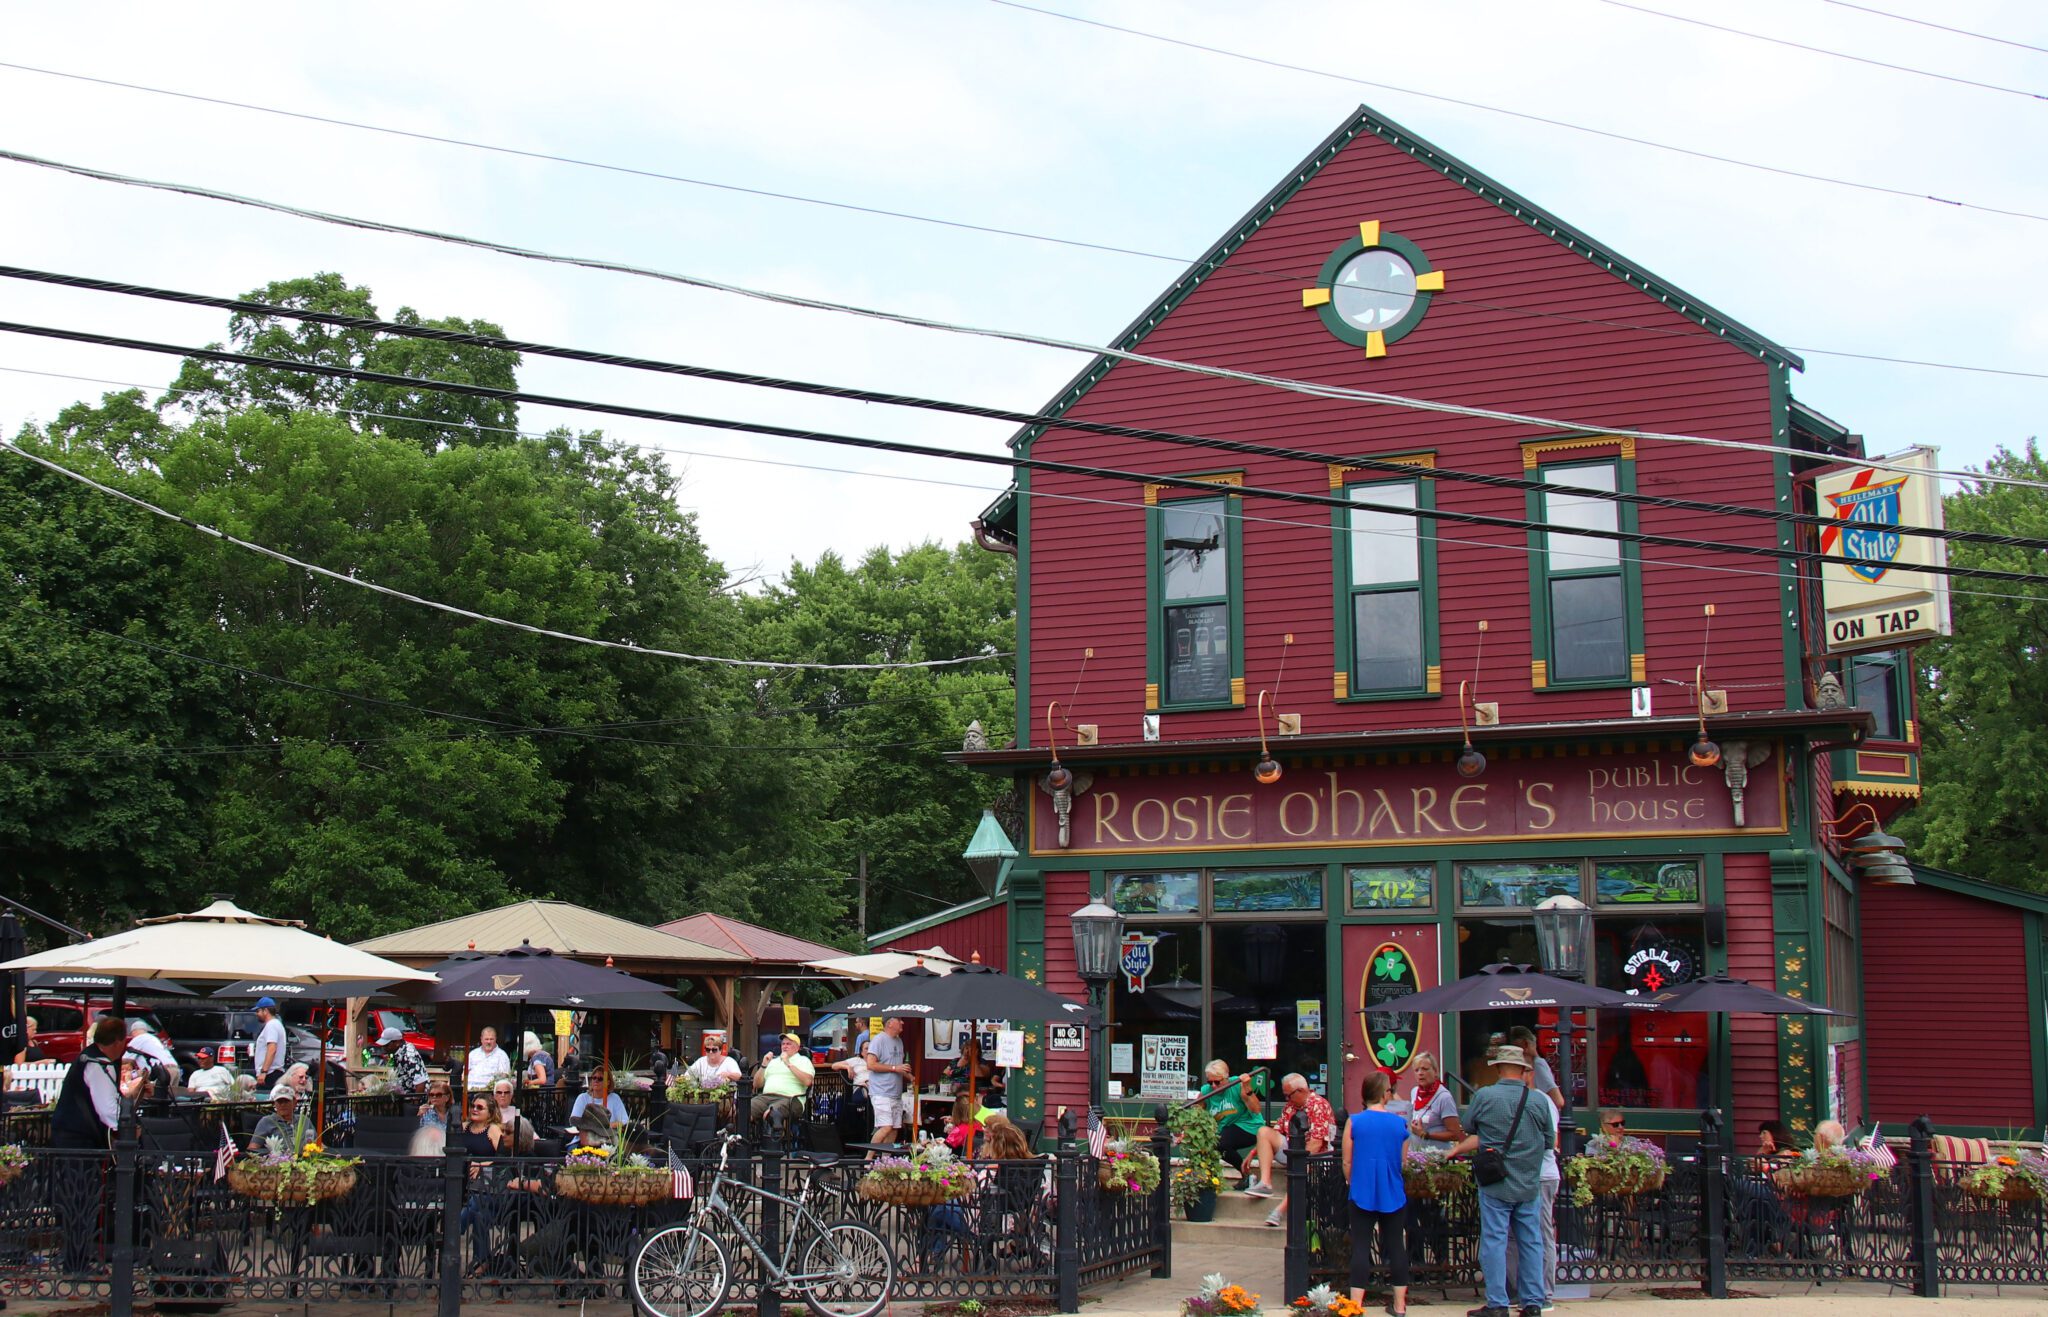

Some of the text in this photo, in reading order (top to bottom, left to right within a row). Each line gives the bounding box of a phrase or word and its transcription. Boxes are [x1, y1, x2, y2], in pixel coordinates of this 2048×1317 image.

[1840, 485, 1895, 504] HEILEMAN'S
[1854, 499, 1888, 534] Old
[1847, 531, 1895, 573] Style
[1833, 609, 1920, 642] ON TAP
[1588, 760, 1704, 795] PUBLIC
[1093, 791, 1253, 843] ROSIE
[1589, 795, 1705, 823] HOUSE
[1368, 879, 1416, 900] 702
[1132, 946, 1147, 958] Old
[1125, 955, 1147, 973] Style
[1624, 948, 1681, 975] STELLA
[58, 977, 114, 985] JAMESON
[246, 984, 305, 994] JAMESON
[464, 989, 530, 997] GUINNESS
[1488, 998, 1556, 1007] GUINNESS
[1057, 1027, 1065, 1037] NO
[1053, 1038, 1081, 1048] SMOKING
[1160, 1048, 1185, 1057] LOVES
[1160, 1061, 1186, 1071] BEER
